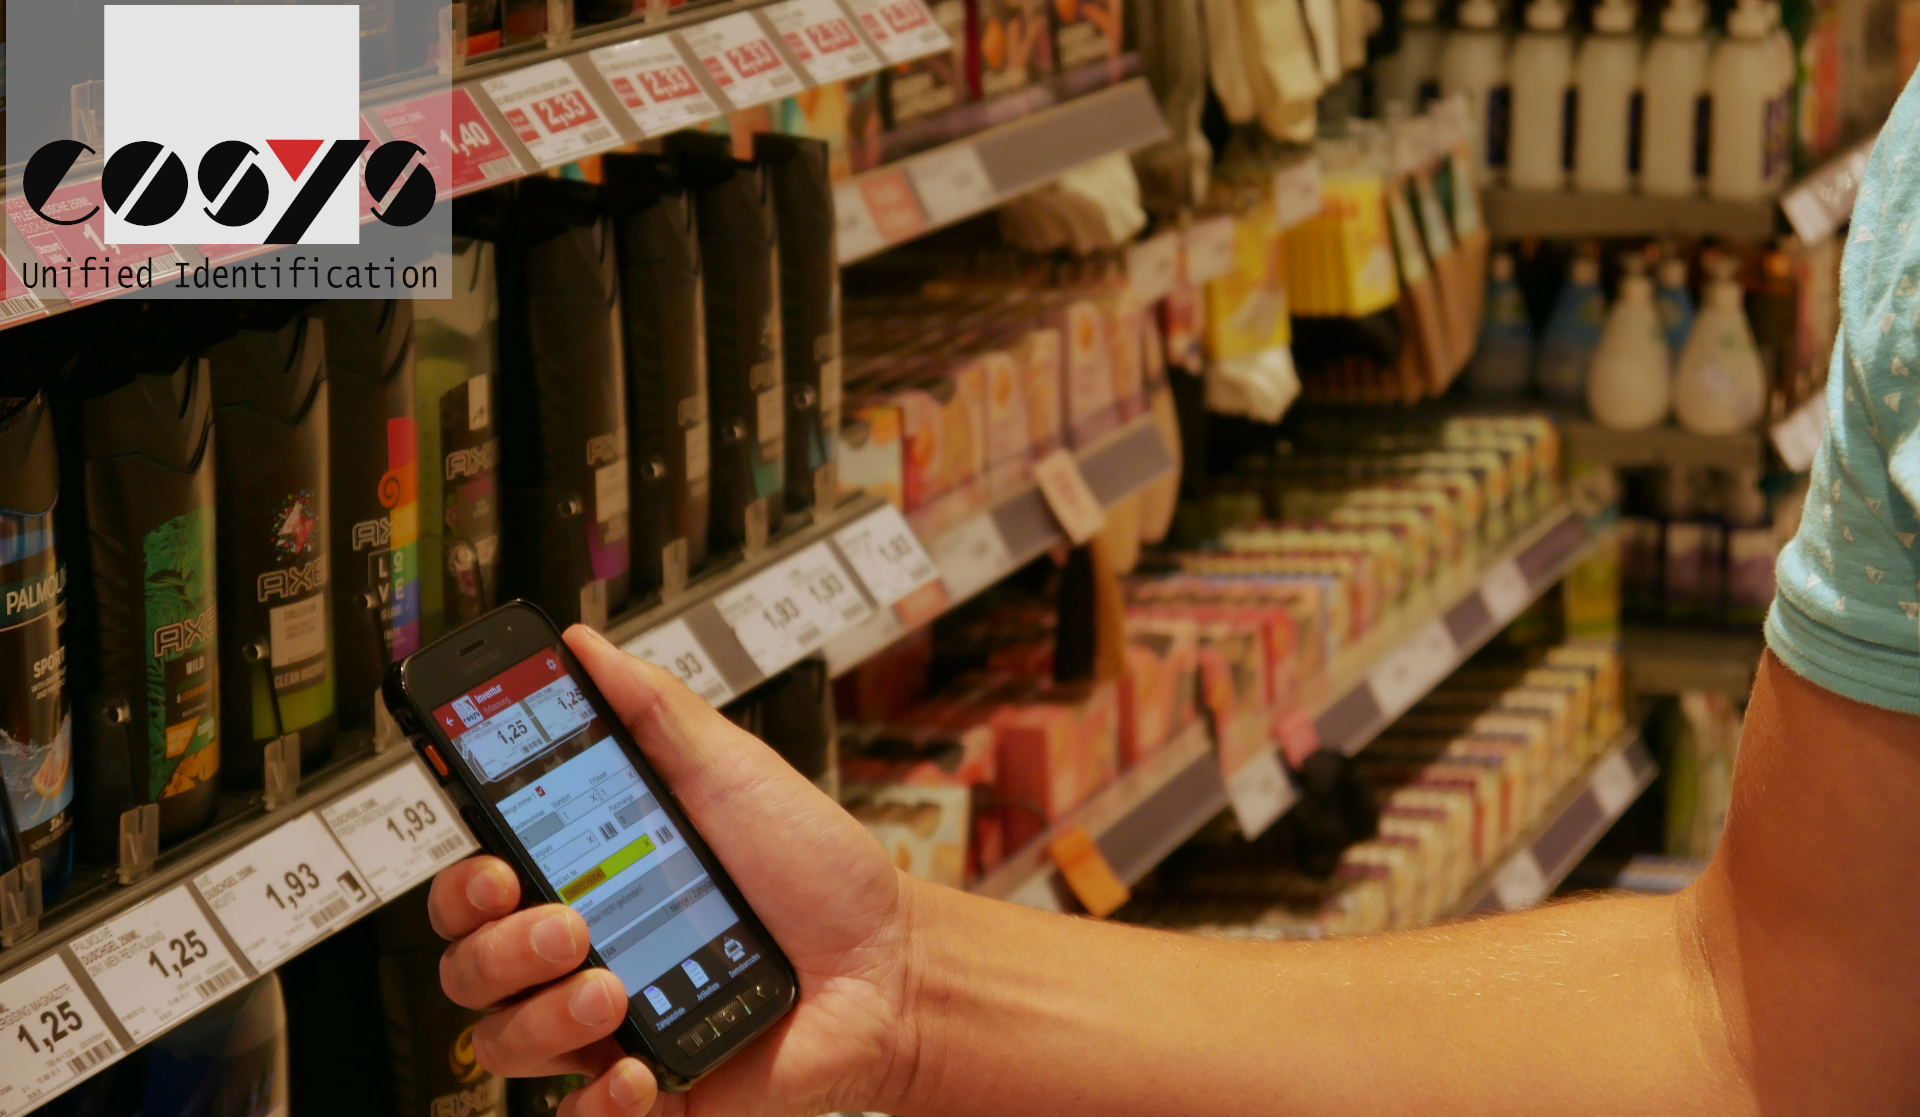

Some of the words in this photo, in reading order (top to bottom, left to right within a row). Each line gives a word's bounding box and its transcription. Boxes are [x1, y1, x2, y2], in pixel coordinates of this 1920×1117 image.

[732, 39, 777, 73] 2,33
[643, 65, 690, 98] 2,33
[538, 92, 587, 128] 2,33
[439, 121, 490, 157] 1,40
[10, 201, 68, 223] PFLEGUSCHE
[879, 534, 913, 566] 1,93
[257, 552, 328, 603] AXE
[809, 573, 844, 604] 1,93
[762, 596, 800, 630] 1,93
[153, 602, 217, 658] AXE
[475, 683, 502, 703] Inventur
[483, 695, 510, 715] Erfassung
[497, 719, 528, 746] 1,25
[551, 793, 570, 807] Standort
[386, 800, 436, 842] 1,93
[204, 875, 237, 899] DUSCHGEL
[266, 863, 320, 909] 1,93
[73, 928, 112, 952] PALMOLIVE
[600, 945, 617, 959] EAN
[669, 896, 691, 913] Menge
[81, 940, 118, 964] DUSCHGEL
[118, 929, 140, 945] 250ML
[102, 953, 121, 968] MEN
[148, 928, 208, 978] 1,25
[696, 982, 720, 1000] Artikelliste
[18, 1000, 83, 1054] 1,25
